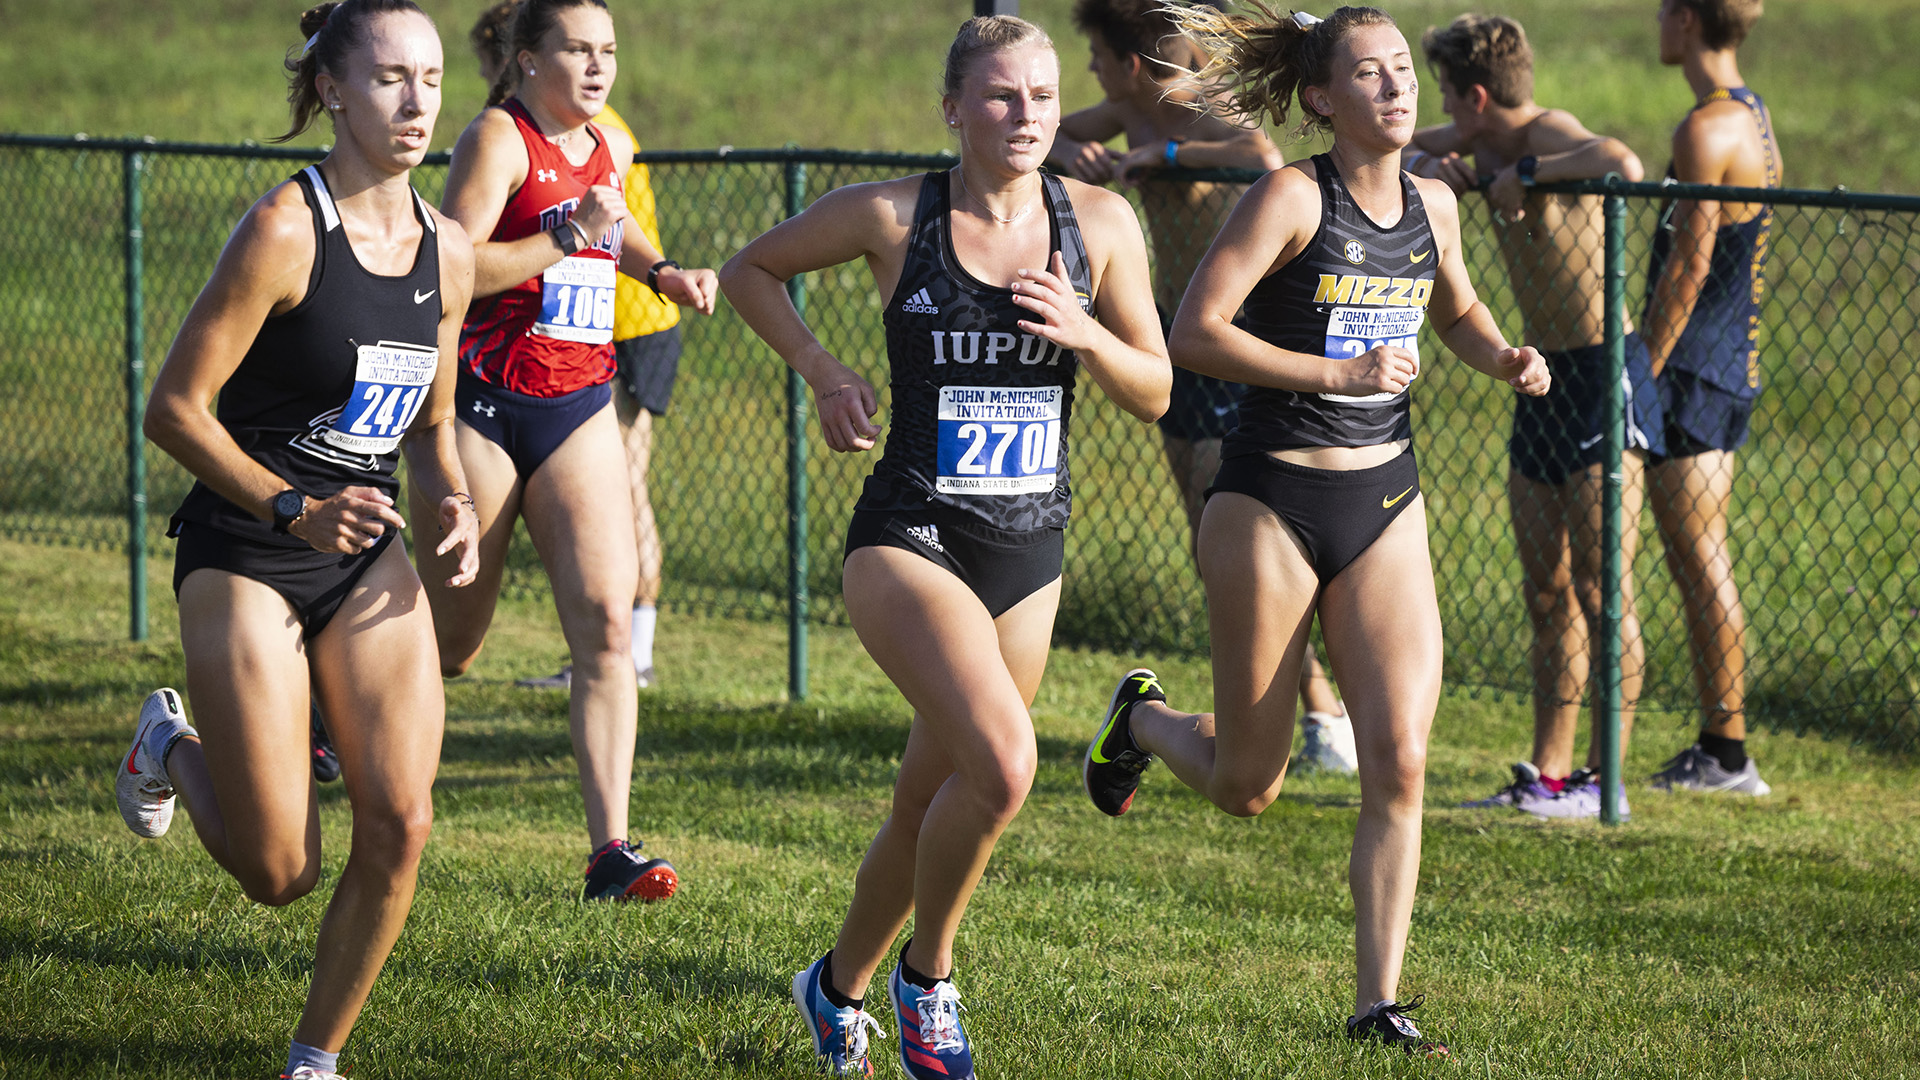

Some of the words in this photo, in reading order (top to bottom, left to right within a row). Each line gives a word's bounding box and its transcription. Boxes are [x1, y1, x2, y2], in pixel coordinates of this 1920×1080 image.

[1346, 243, 1364, 263] SEC
[902, 302, 939, 315] adidas
[1338, 311, 1370, 323] JOHN
[1374, 311, 1419, 324] McNICHOLS
[1343, 324, 1409, 337] INVITATIONAL
[931, 330, 1064, 366] IUPUI
[364, 350, 390, 366] JOHN
[368, 366, 428, 383] INVITATIONAL
[949, 390, 985, 404] JOHN
[989, 390, 1055, 404] McNICHOLS
[956, 404, 1048, 419] INVITATIONAL
[334, 434, 362, 447] INDIANA
[946, 479, 981, 489] INDIANA
[983, 479, 1008, 489] STATE
[906, 527, 944, 554] adidas
